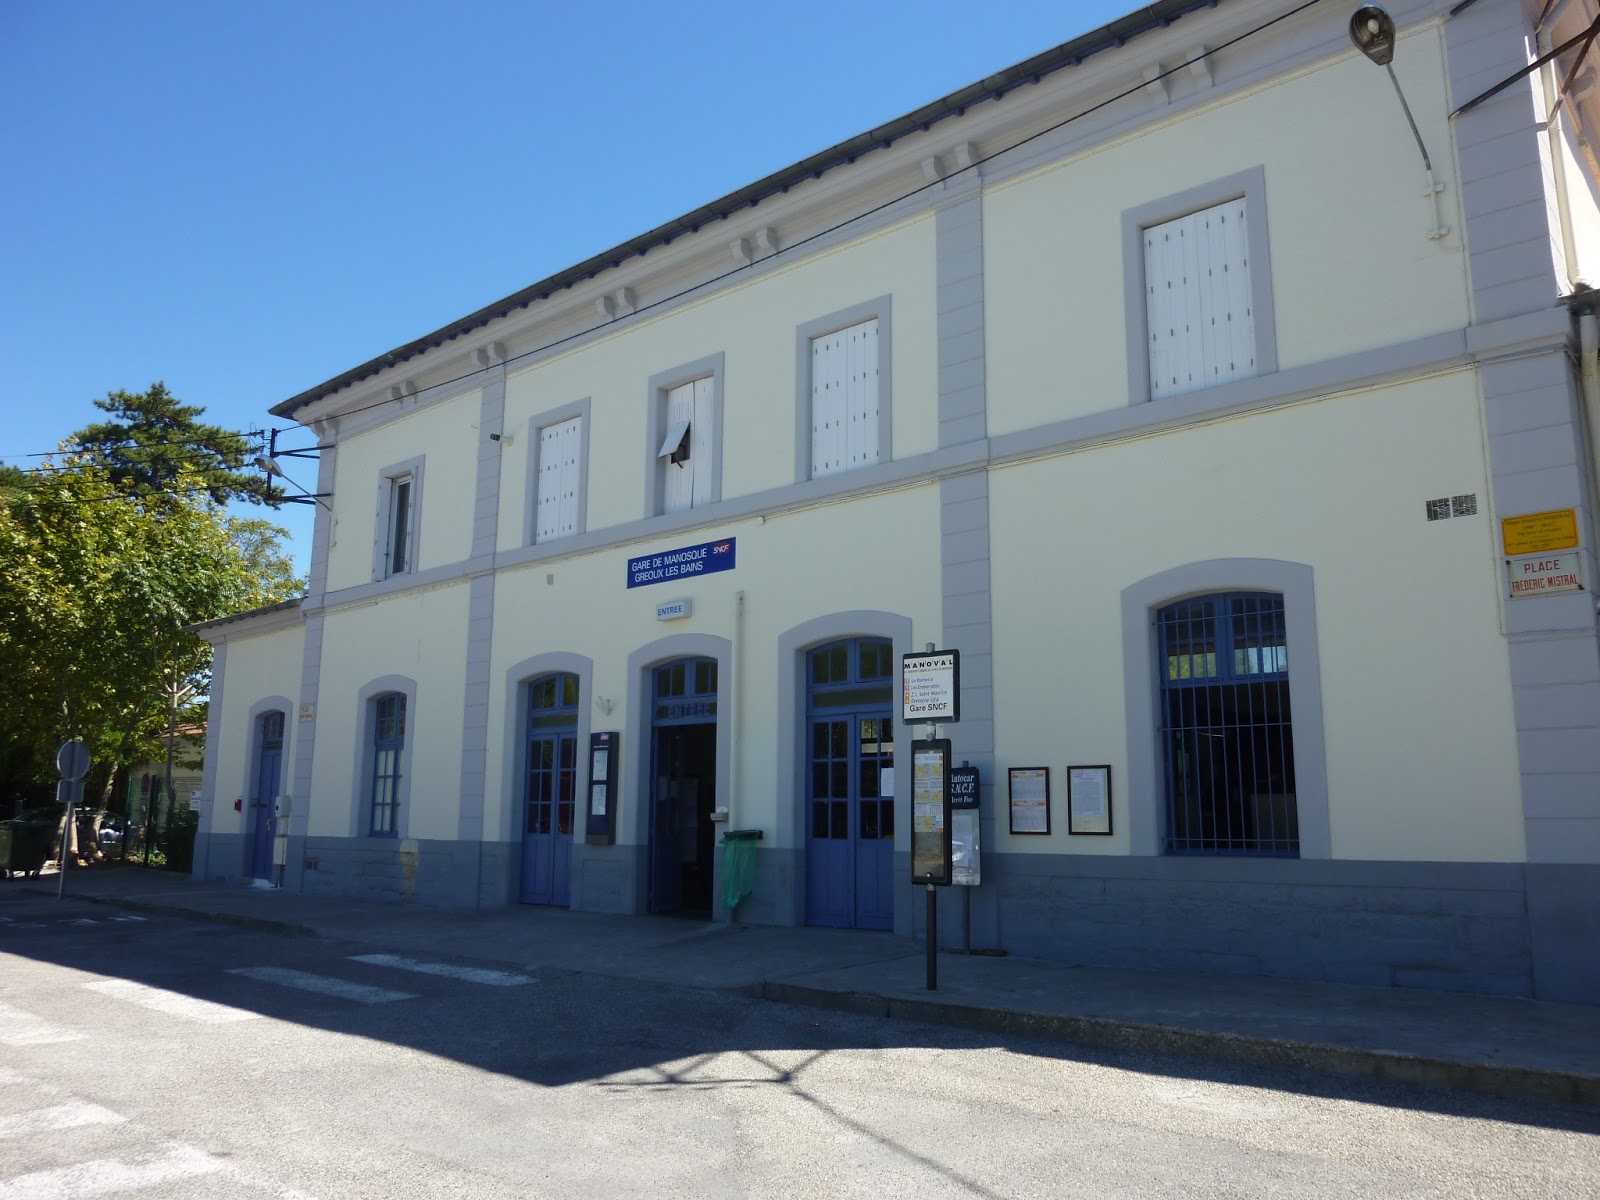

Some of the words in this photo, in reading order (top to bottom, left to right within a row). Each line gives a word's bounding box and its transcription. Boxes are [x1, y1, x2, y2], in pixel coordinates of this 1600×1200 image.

[713, 544, 730, 555] SNCF
[632, 560, 651, 572] GARE
[652, 558, 663, 568] DE
[664, 548, 708, 565] MANOSQUE
[634, 570, 664, 583] GREOUX
[665, 566, 679, 577] LES
[680, 561, 704, 574] BAINS
[1524, 560, 1561, 574] PLACE
[1511, 577, 1546, 593] FREDERIC
[1547, 574, 1579, 588] MISTRAL
[657, 605, 683, 616] ENTREE
[904, 659, 953, 669] MANOVAL
[910, 704, 926, 712] Gare
[927, 703, 948, 711] SNCF
